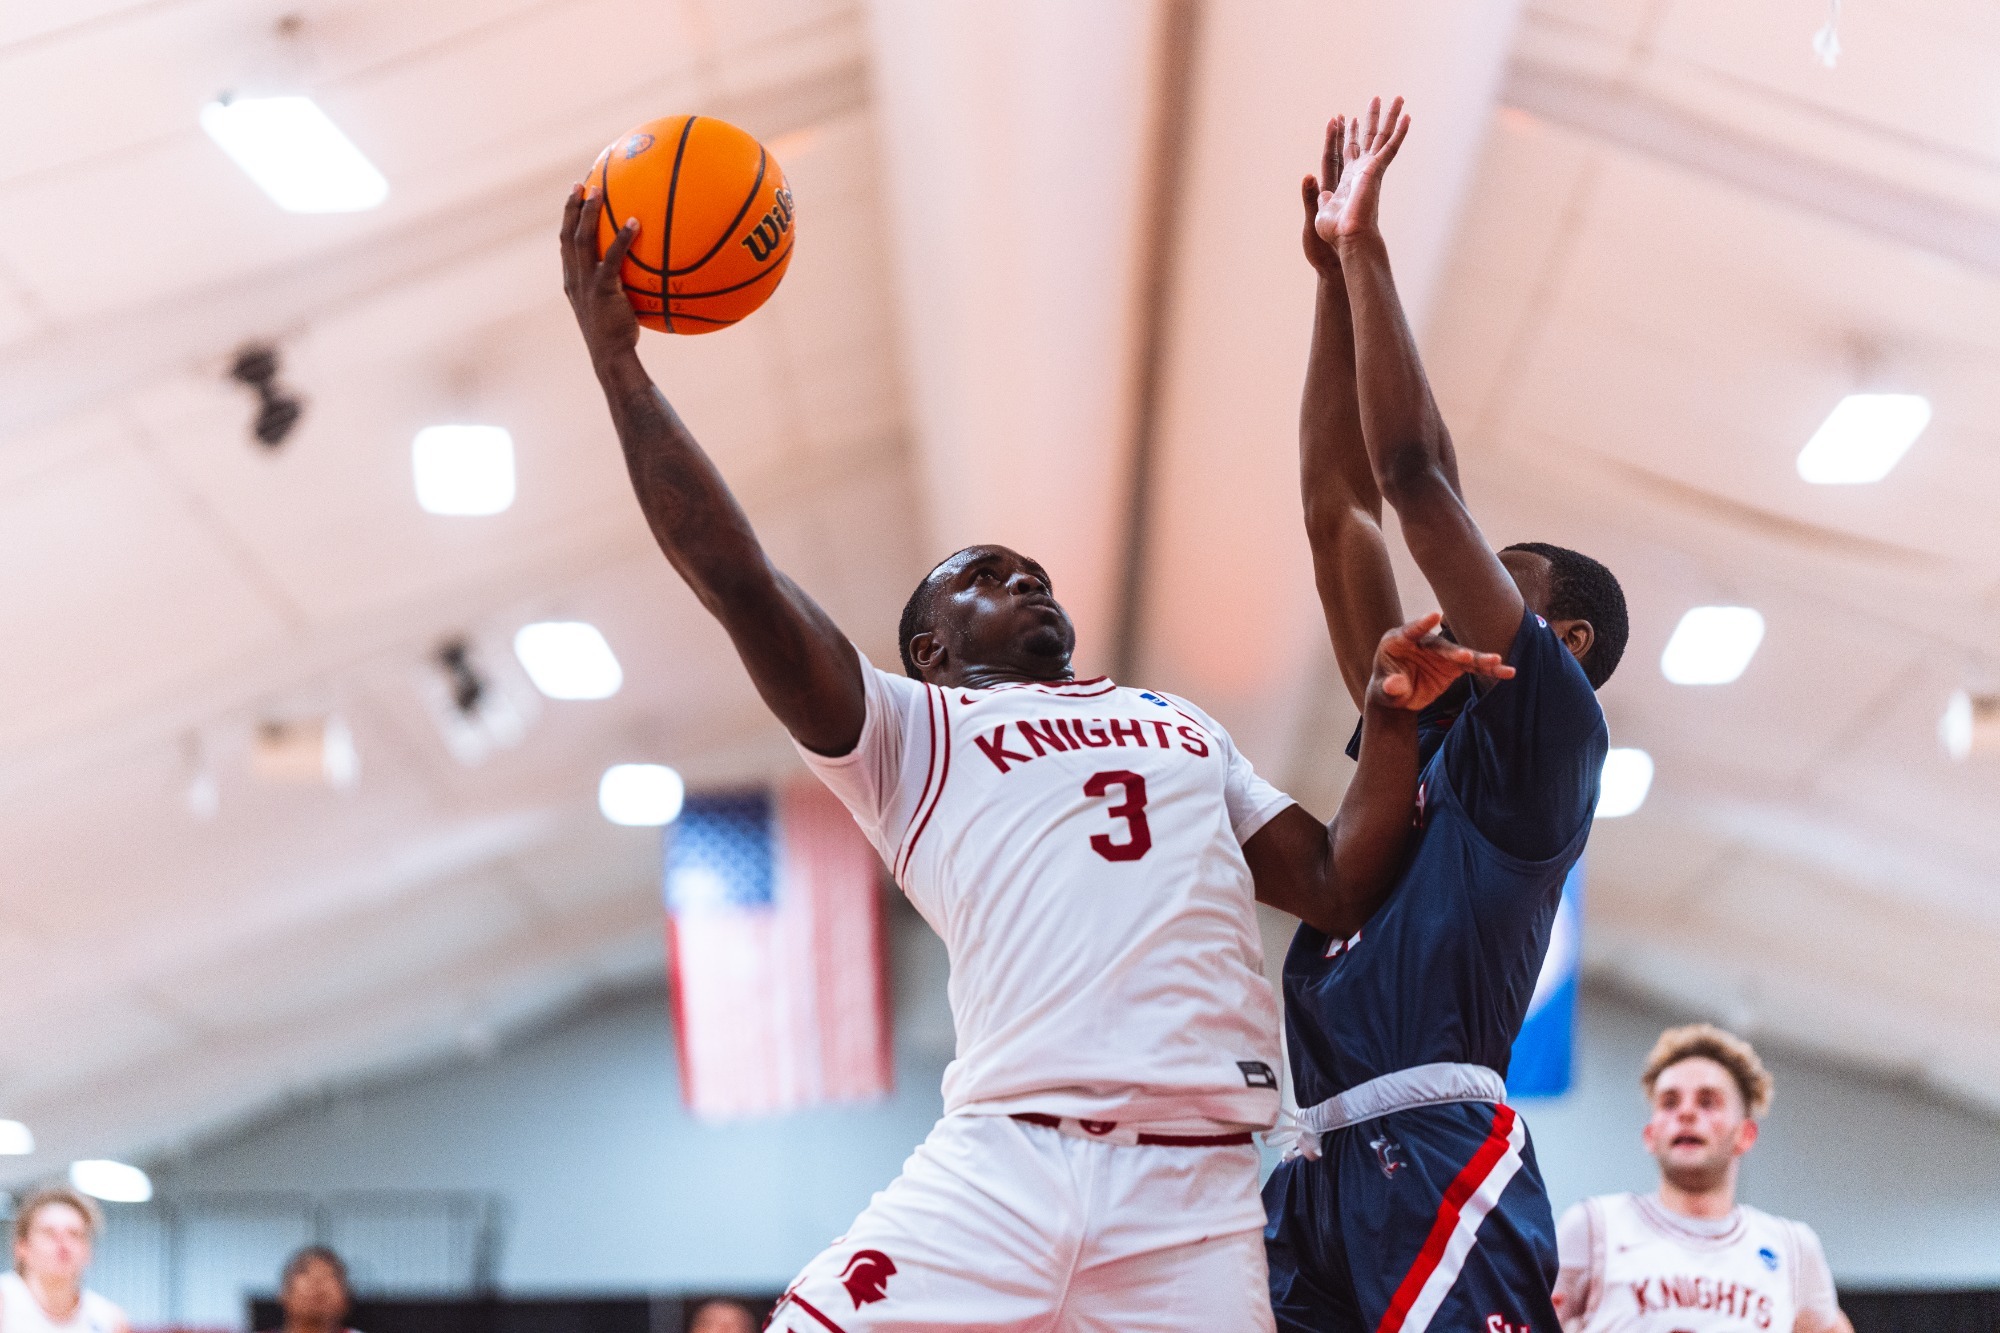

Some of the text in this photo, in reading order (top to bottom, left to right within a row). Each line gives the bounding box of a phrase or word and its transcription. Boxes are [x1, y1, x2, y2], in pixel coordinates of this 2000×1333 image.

[741, 188, 794, 262] Wil
[973, 718, 1209, 774] KNIGHTS
[1083, 770, 1152, 862] 3
[1630, 1276, 1773, 1329] KNIGHTS
